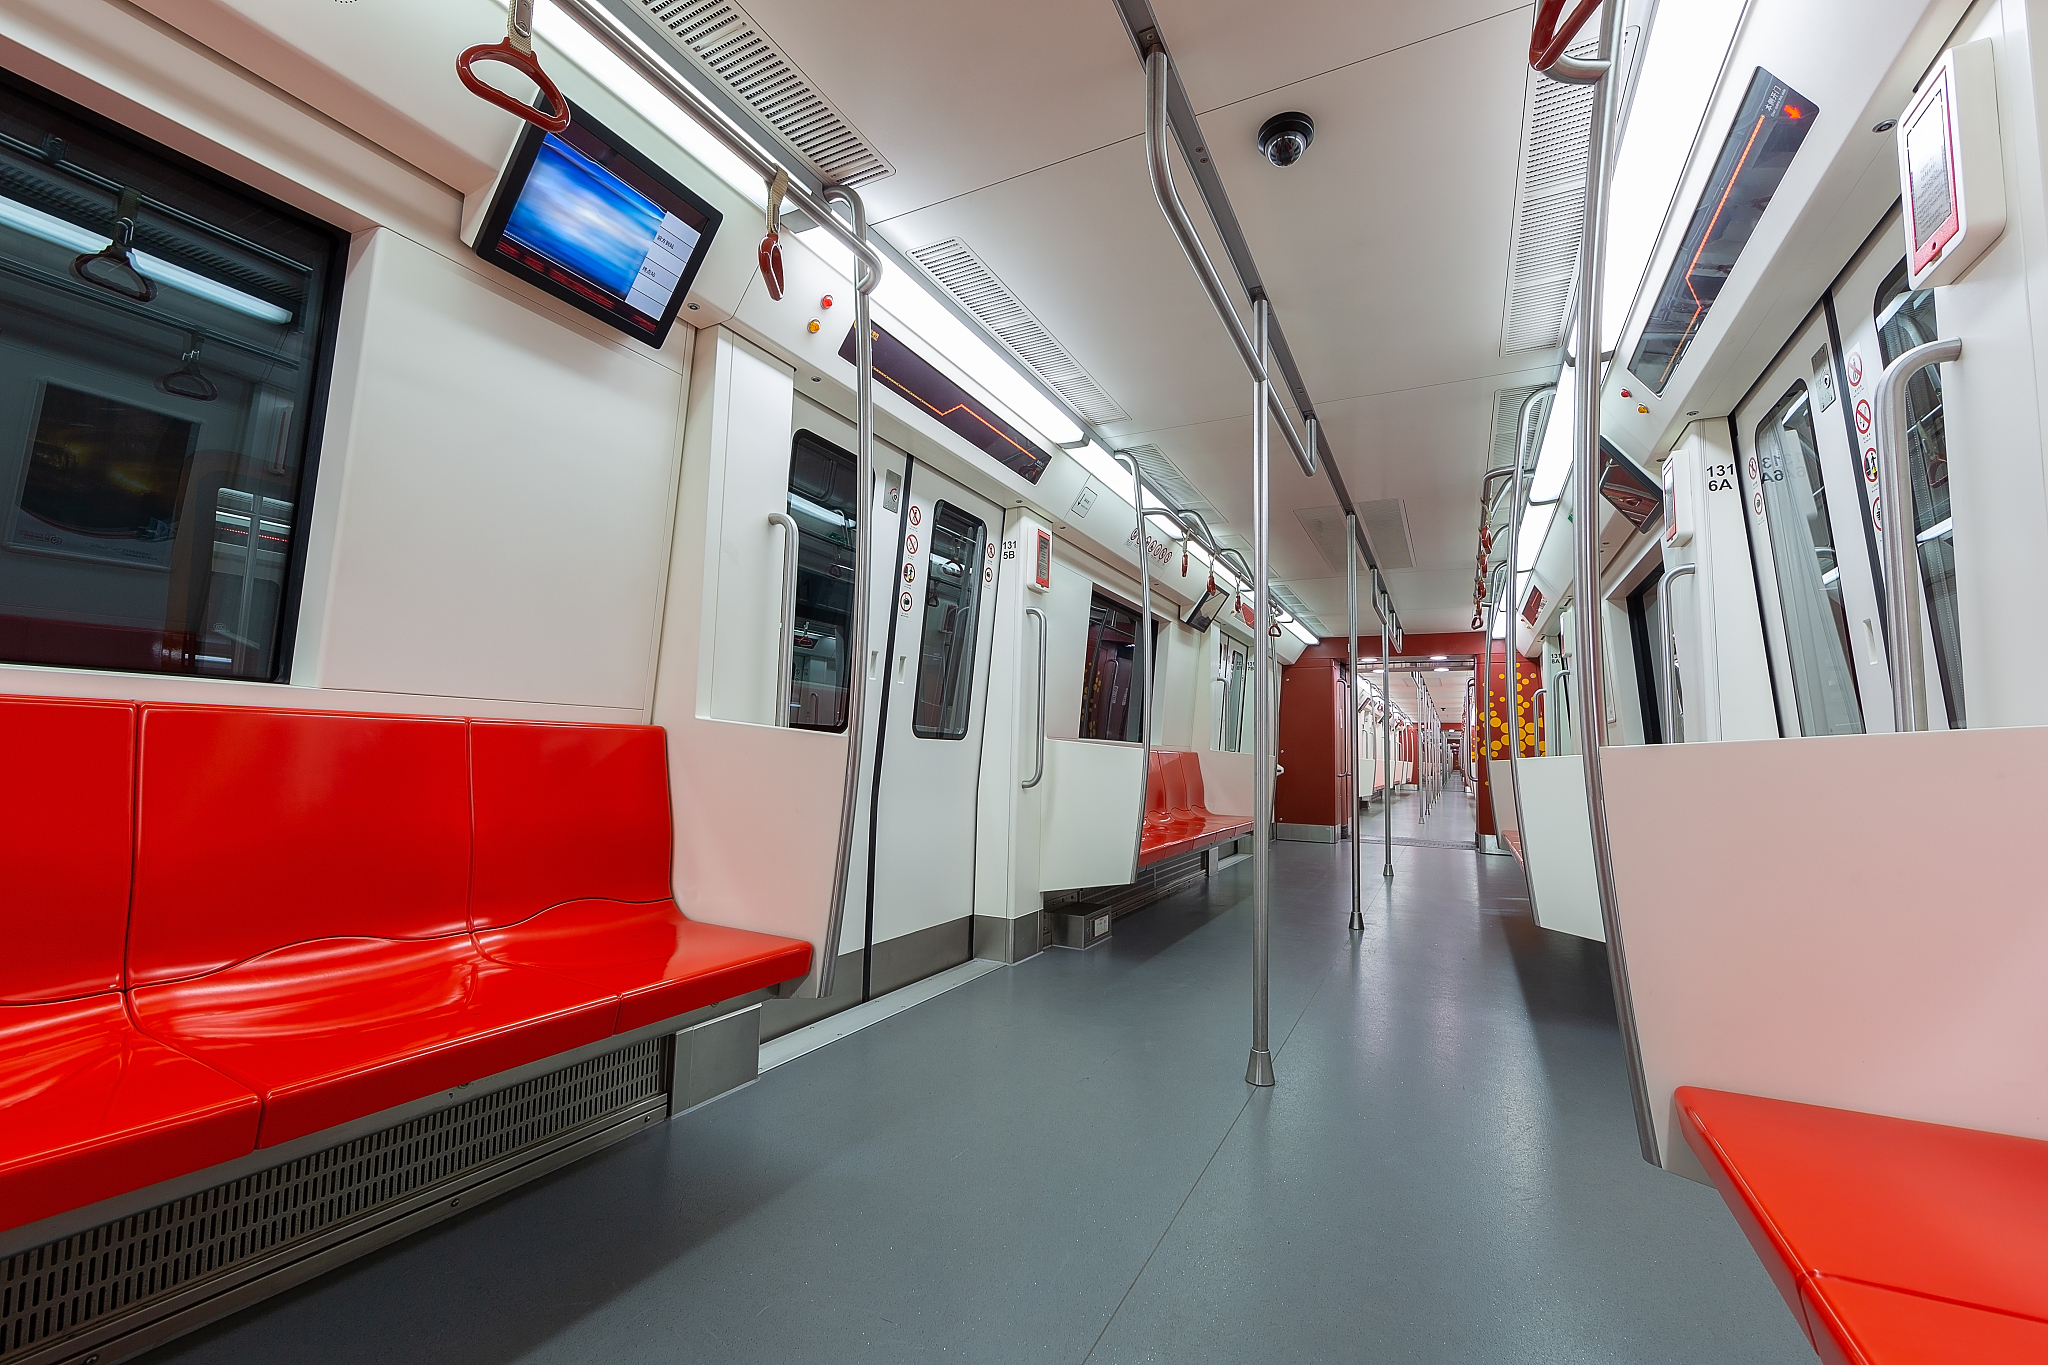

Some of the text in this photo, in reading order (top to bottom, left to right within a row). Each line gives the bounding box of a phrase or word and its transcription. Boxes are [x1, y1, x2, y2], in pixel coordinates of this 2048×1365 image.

[1765, 85, 1781, 111] 本侧开门
[1706, 463, 1734, 477] 131
[1708, 478, 1733, 491] 6A
[1003, 540, 1016, 549] 131
[1003, 551, 1015, 559] 5B
